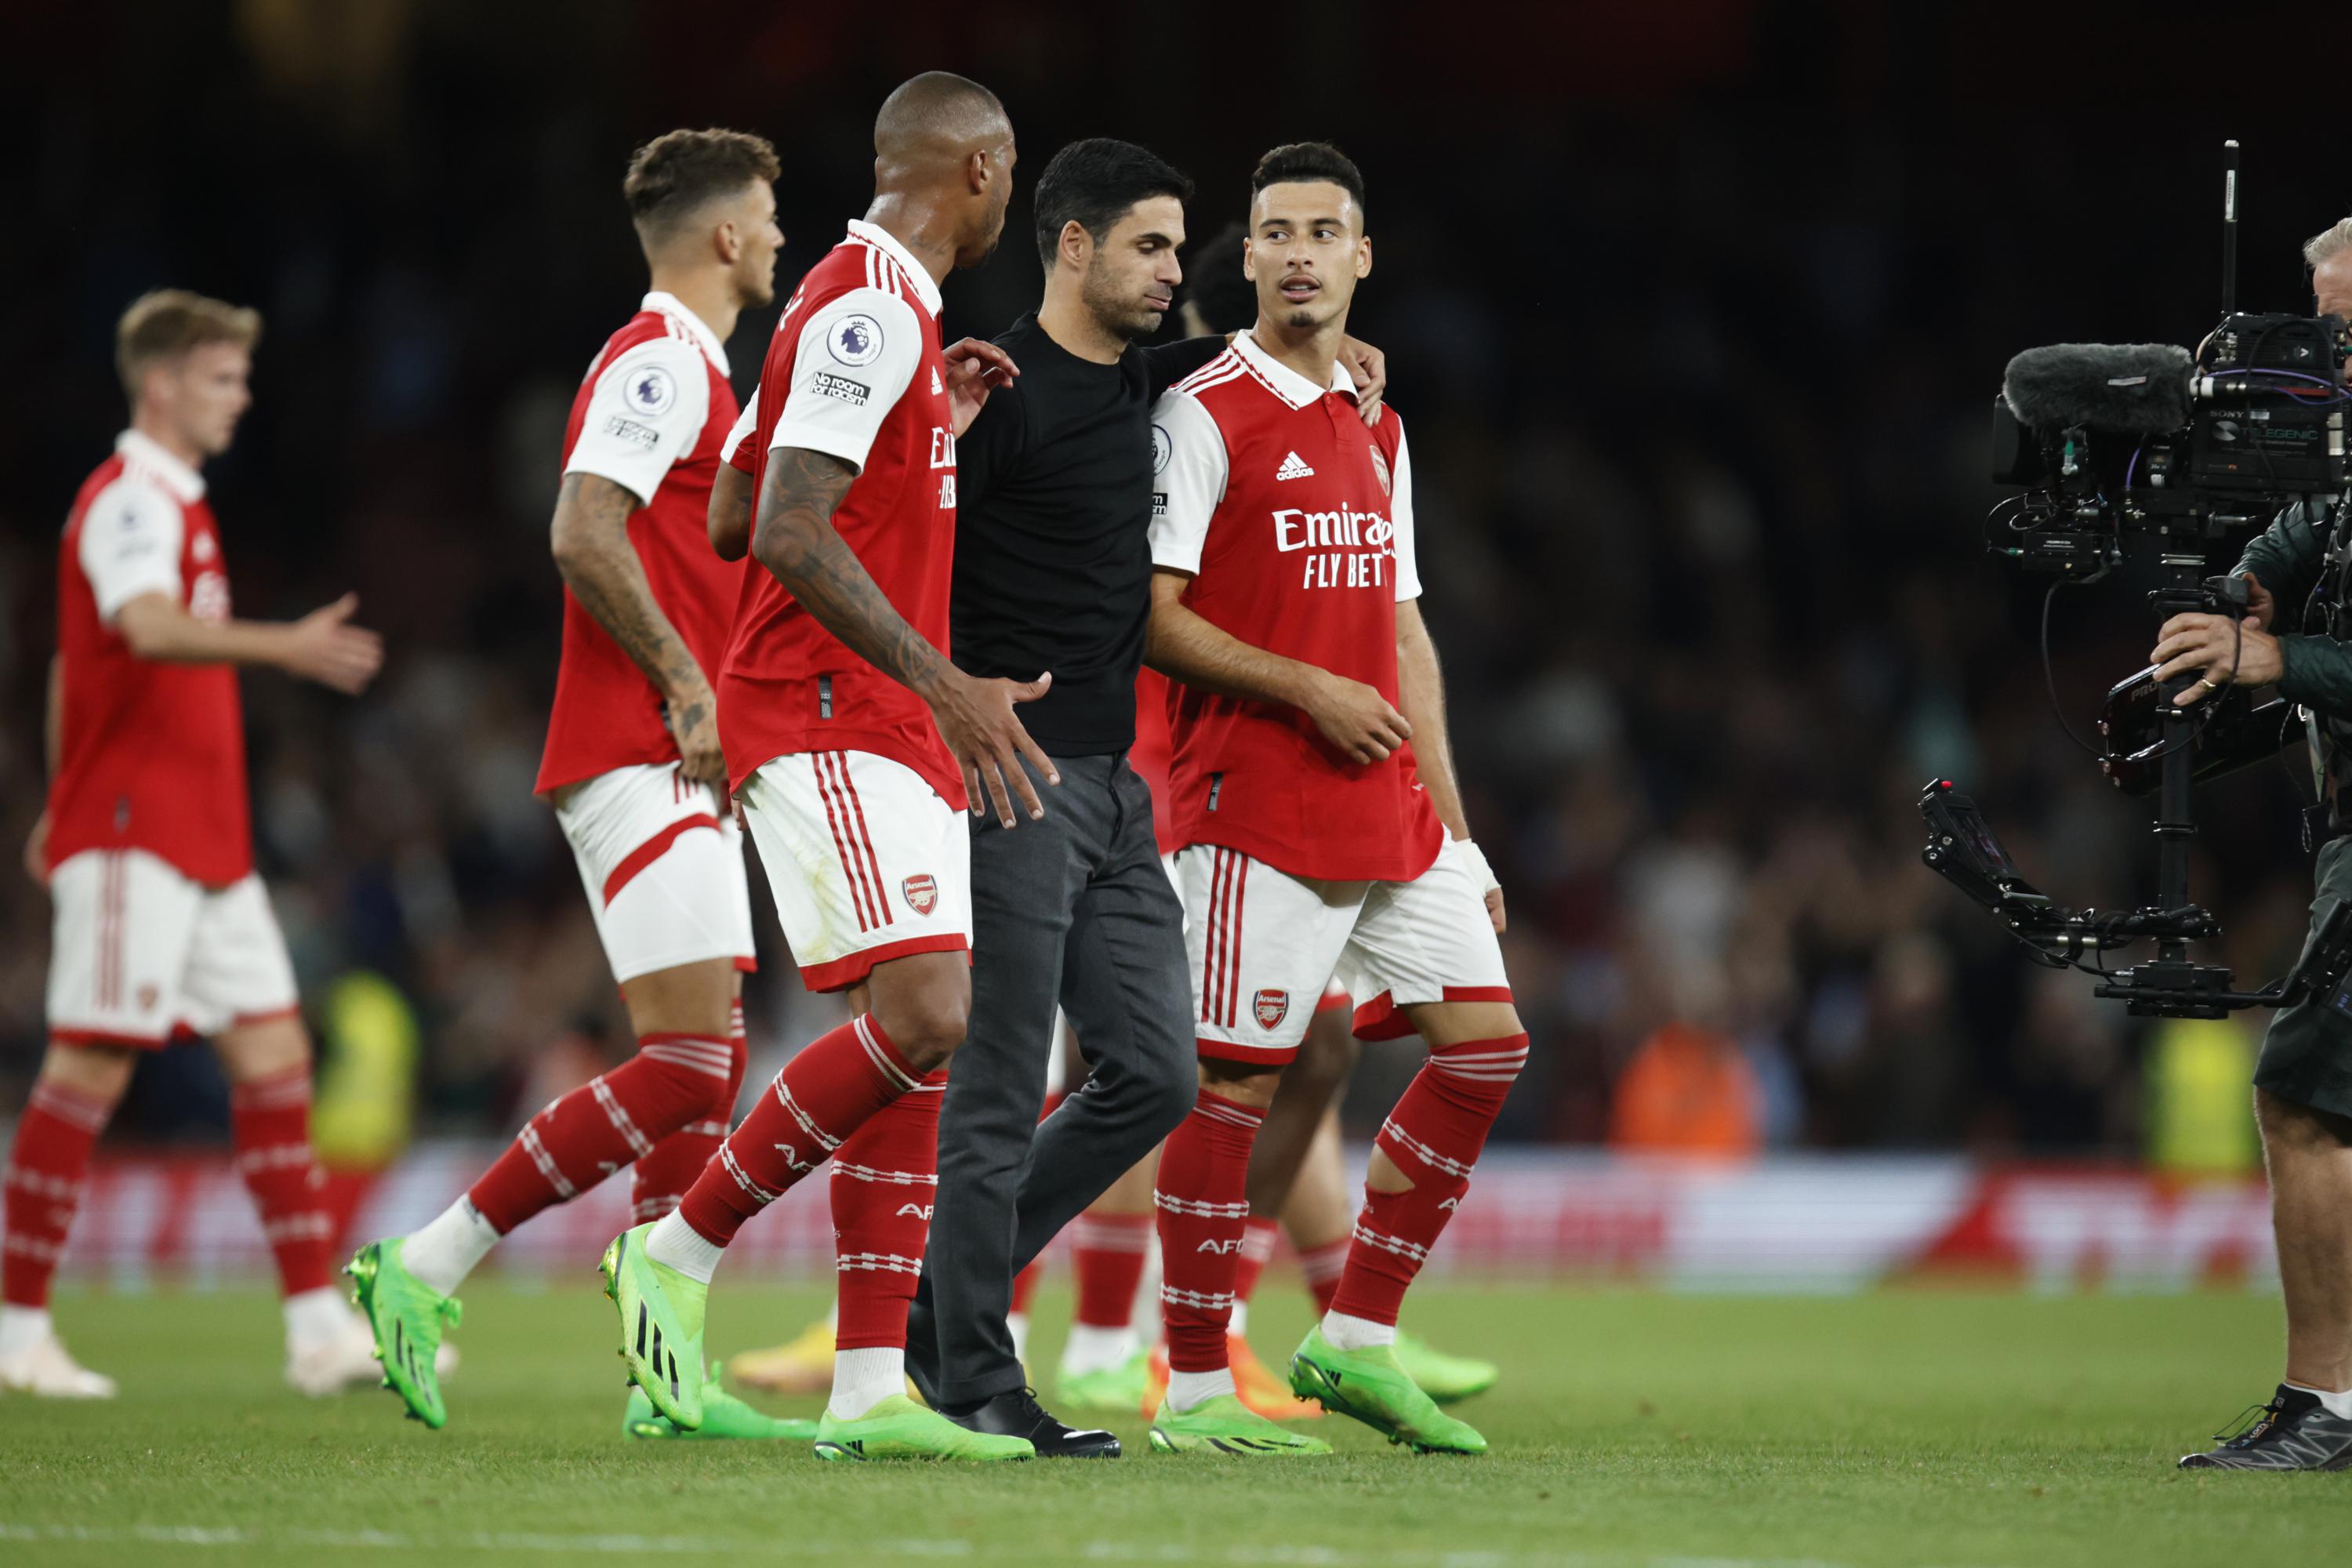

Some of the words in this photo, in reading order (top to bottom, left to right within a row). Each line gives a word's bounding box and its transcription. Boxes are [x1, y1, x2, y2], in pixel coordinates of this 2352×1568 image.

[814, 372, 831, 386] No
[831, 377, 865, 396] room
[810, 383, 829, 395] for
[827, 387, 866, 405] racism
[2209, 409, 2245, 418] SONY
[1276, 468, 1315, 481] adidas
[1303, 554, 1341, 589] FLY
[1347, 553, 1387, 587] BET
[1258, 994, 1286, 1003] Arsenal
[774, 1144, 816, 1171] AF
[896, 1203, 935, 1220] AF
